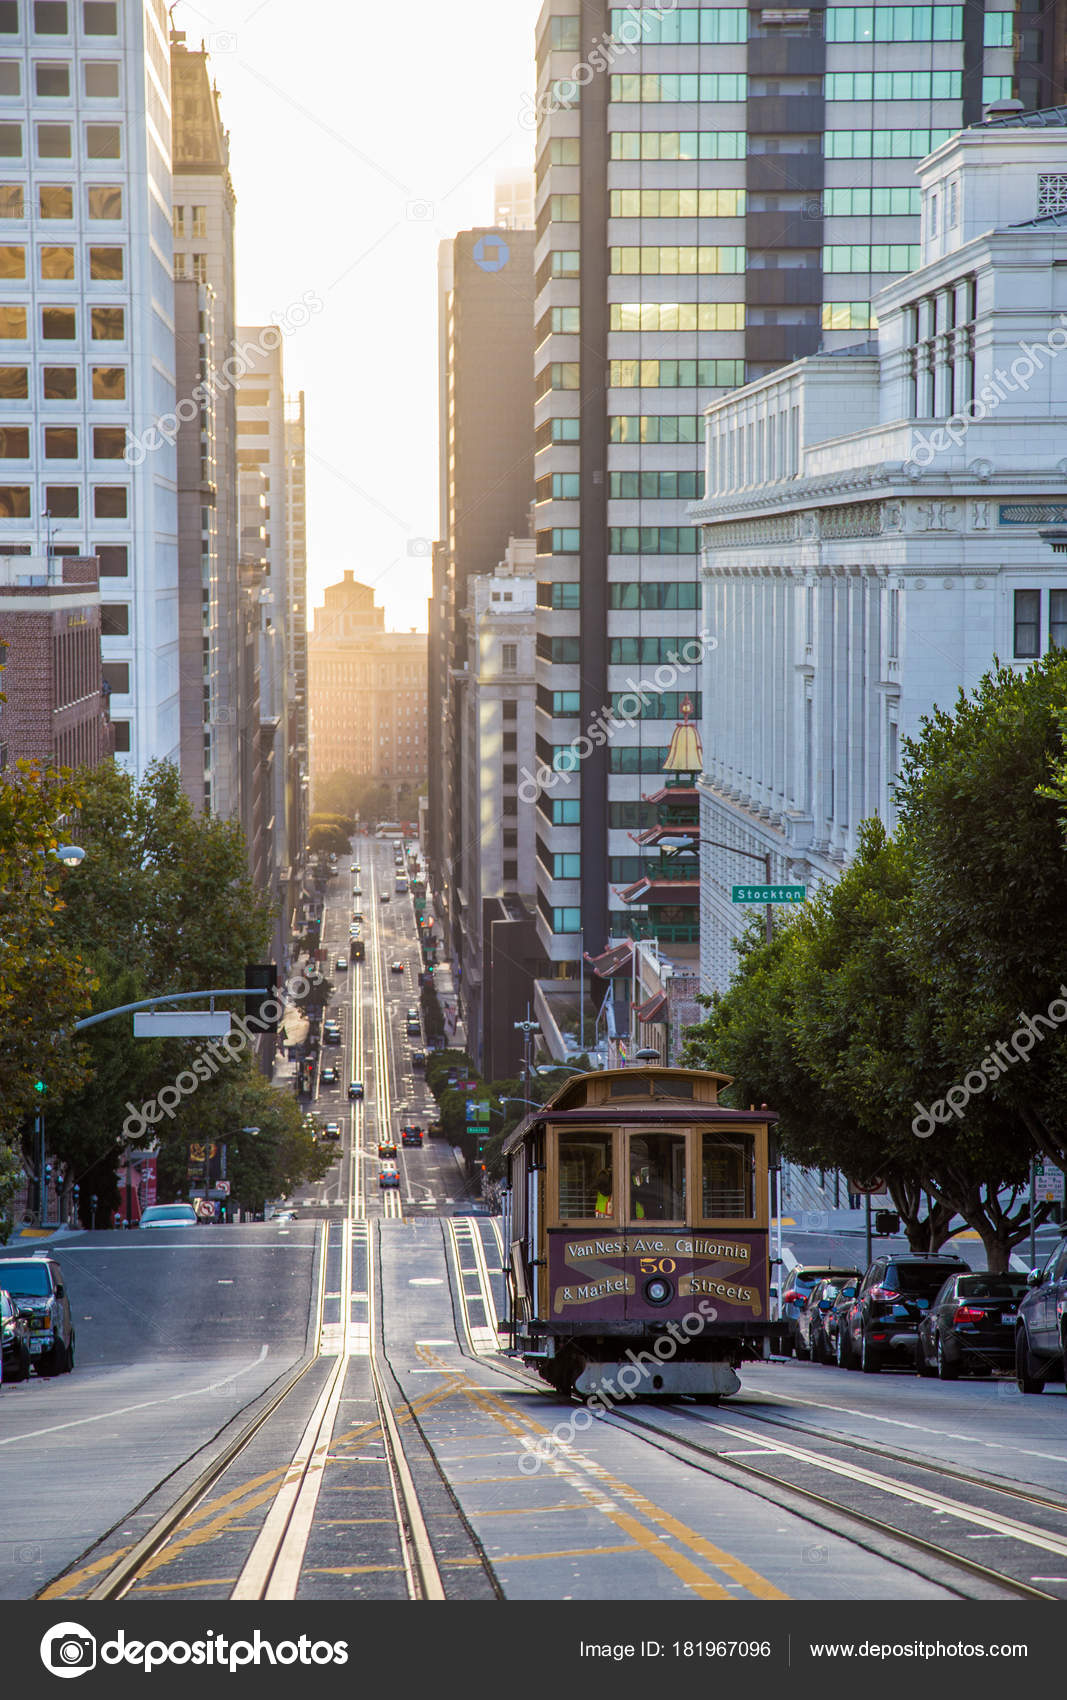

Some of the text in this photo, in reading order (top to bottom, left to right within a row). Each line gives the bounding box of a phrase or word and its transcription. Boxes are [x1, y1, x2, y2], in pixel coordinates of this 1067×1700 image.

[737, 889, 801, 899] Stockton
[568, 1244, 593, 1257] Van
[595, 1241, 629, 1254] Ness
[674, 1239, 749, 1259] California
[639, 1257, 677, 1274] 50
[563, 1278, 751, 1301] & Market Streets
